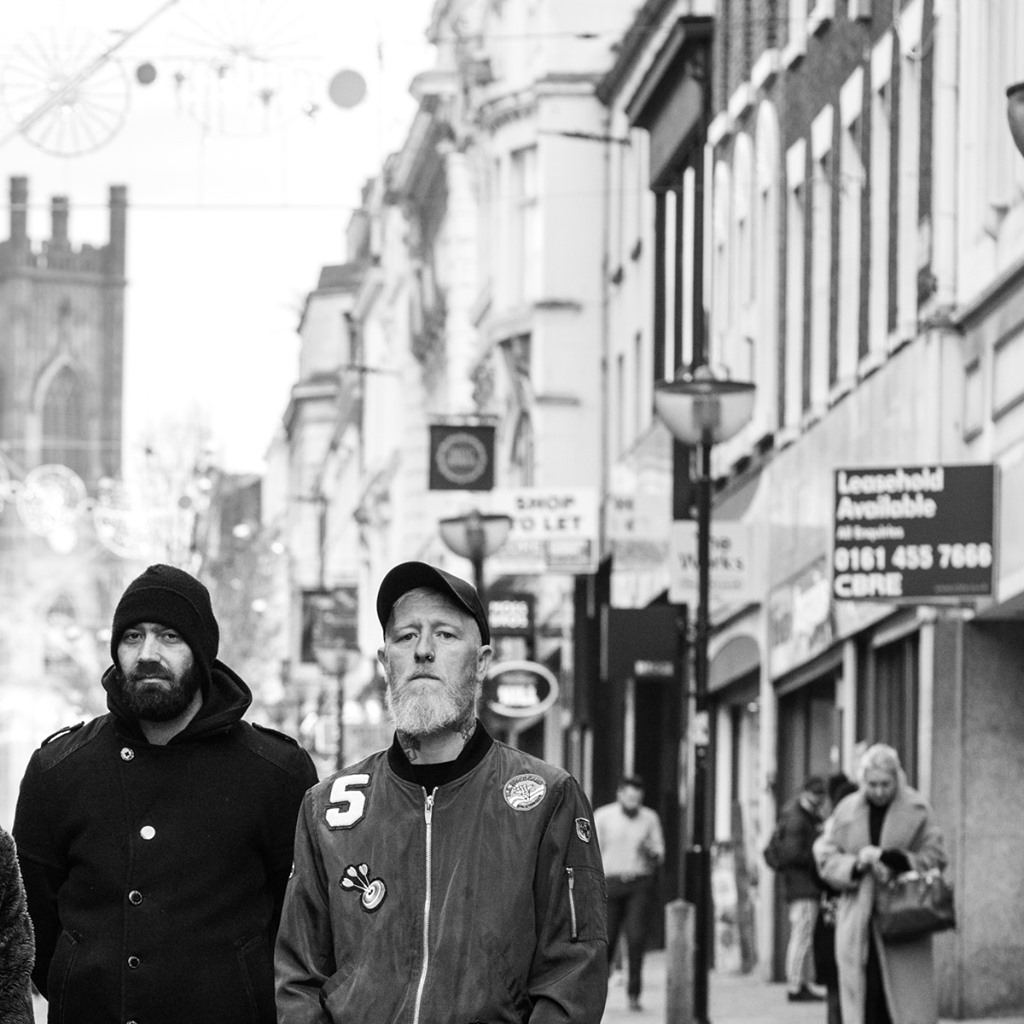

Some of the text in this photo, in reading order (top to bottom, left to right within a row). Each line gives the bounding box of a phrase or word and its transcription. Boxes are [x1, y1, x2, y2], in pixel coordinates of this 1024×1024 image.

[837, 466, 944, 495] Leasehold
[516, 496, 575, 511] SHOP
[836, 492, 937, 520] Available
[543, 516, 582, 531] LET
[834, 546, 886, 572] 0161
[891, 544, 934, 570] 455
[834, 572, 904, 598] CBRE
[325, 773, 371, 829] 5
